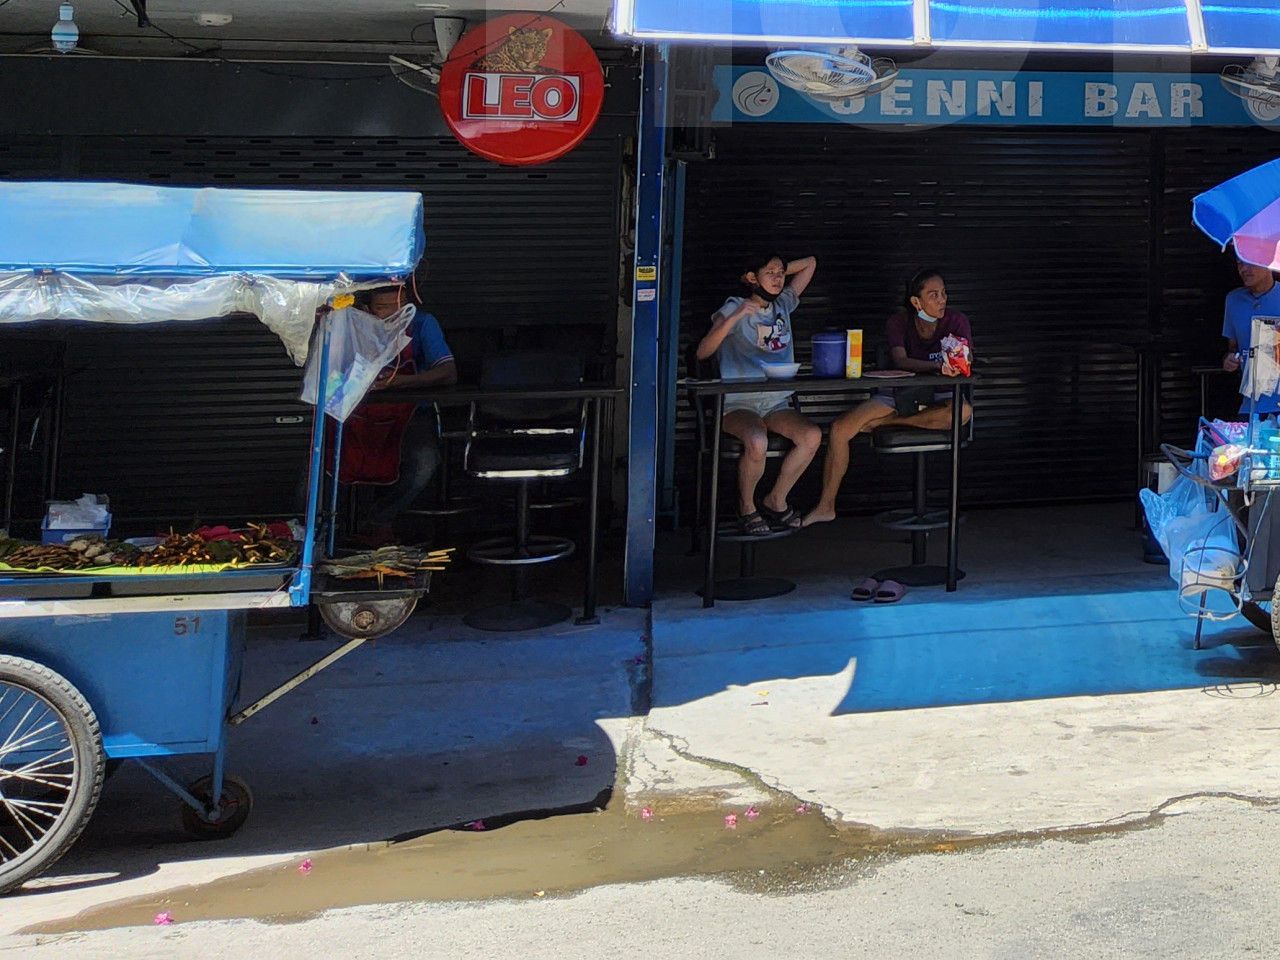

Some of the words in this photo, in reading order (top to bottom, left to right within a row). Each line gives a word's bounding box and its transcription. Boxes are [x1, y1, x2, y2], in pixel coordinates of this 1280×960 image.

[467, 74, 578, 120] LEO
[1084, 82, 1204, 118] BAR
[173, 615, 202, 636] 51
